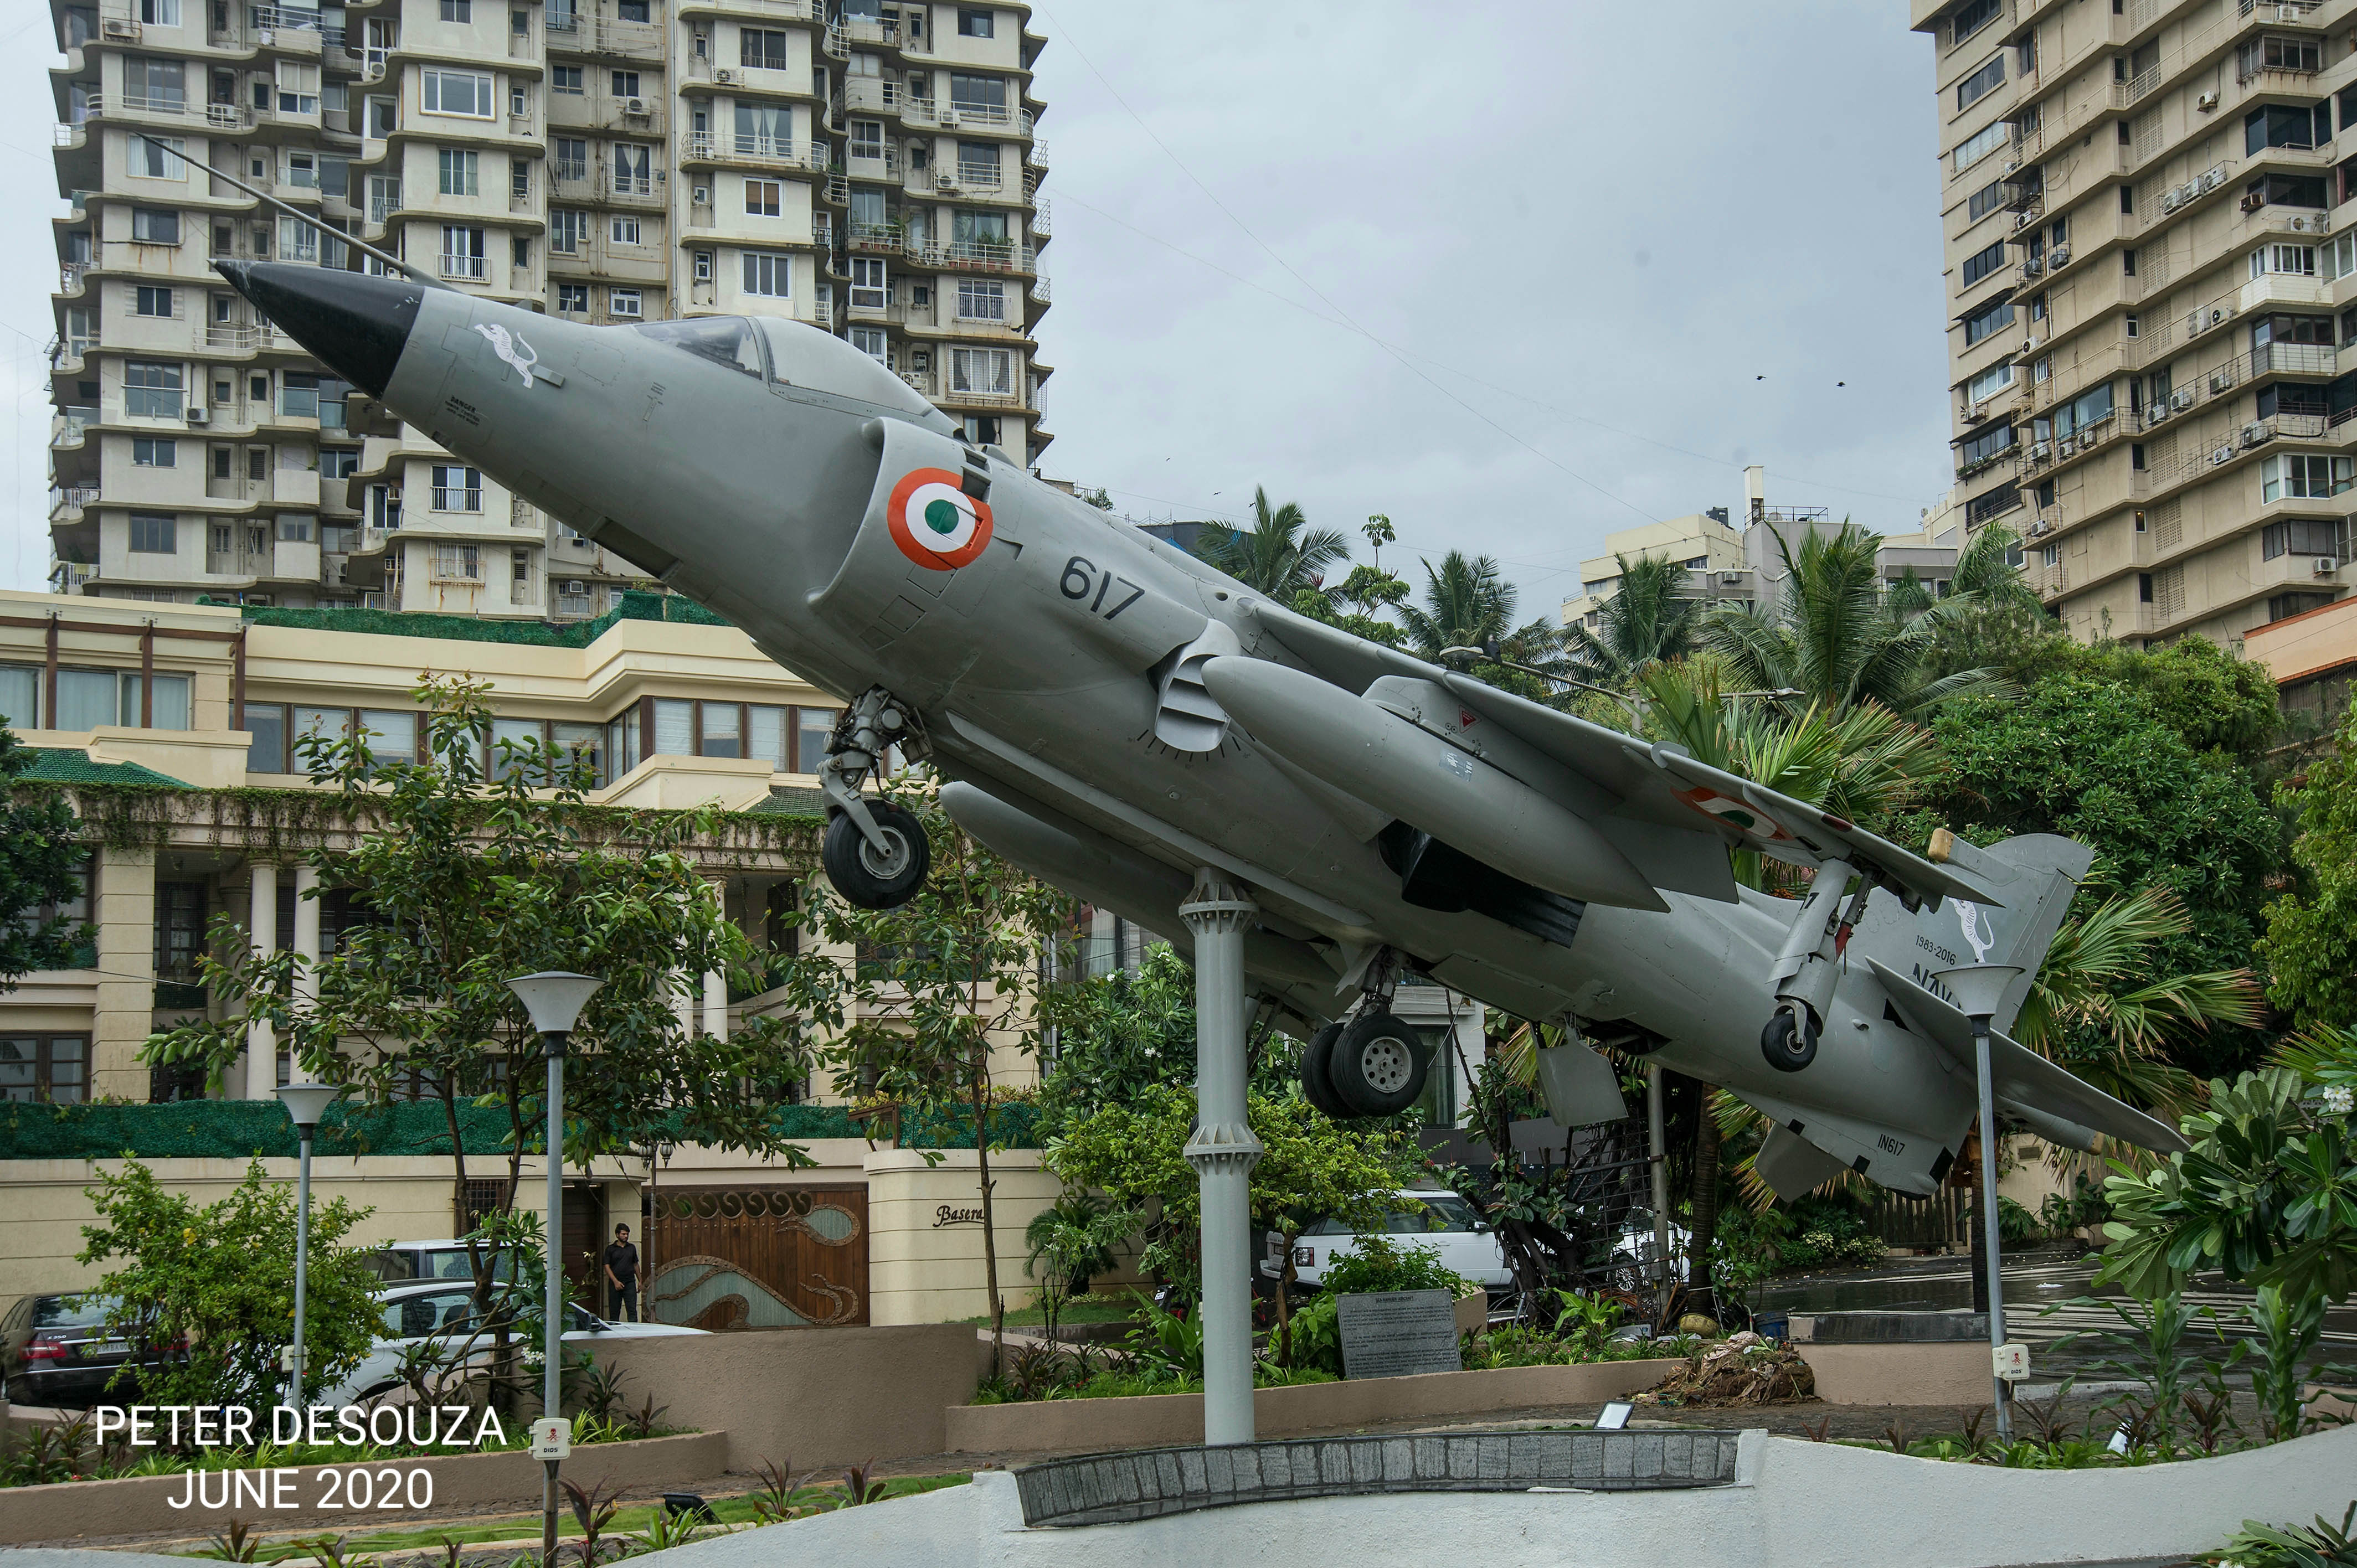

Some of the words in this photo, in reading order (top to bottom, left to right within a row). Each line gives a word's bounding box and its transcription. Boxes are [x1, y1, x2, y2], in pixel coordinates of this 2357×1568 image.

[1059, 556, 1145, 620] 617
[1916, 935, 1956, 965] 1983-2016
[1913, 963, 1961, 1010] NAV
[1877, 1133, 1906, 1157] IN617
[932, 1205, 985, 1227] Basera
